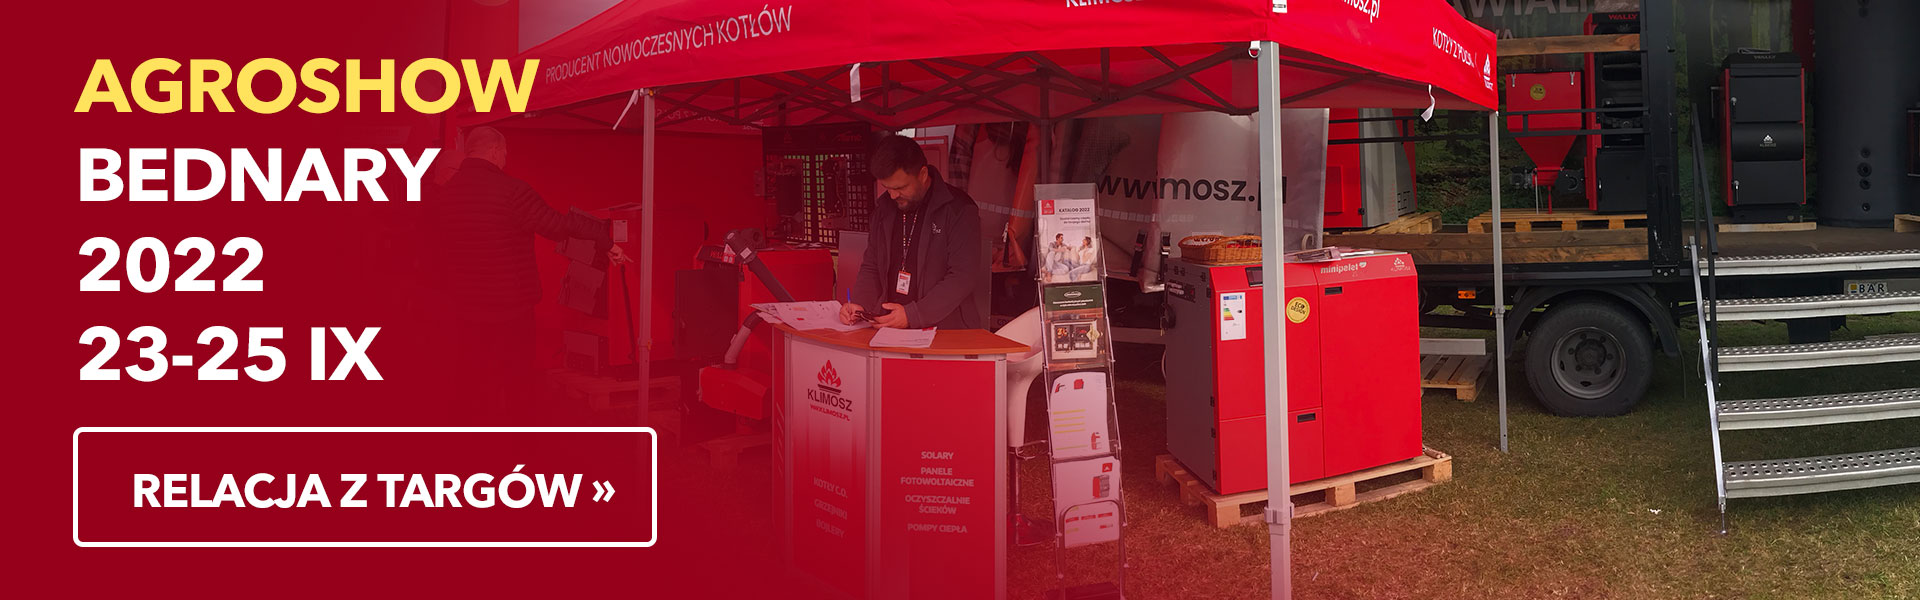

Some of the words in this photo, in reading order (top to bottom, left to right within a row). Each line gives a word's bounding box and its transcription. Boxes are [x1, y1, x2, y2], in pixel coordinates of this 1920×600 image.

[545, 52, 601, 84] PRODUCENT
[602, 24, 714, 67] NOWOCZESNYCH
[716, 4, 792, 44] KOTŁÓW
[1859, 283, 1885, 294] BÄR
[807, 388, 853, 412] KLIMOSZ
[921, 451, 954, 459] SOLARY
[920, 467, 953, 475] PANELE
[900, 477, 975, 487] FOTOWOLTAICZNE
[905, 495, 971, 505] OCZYSZCZALNIE
[919, 503, 957, 514] ŚCIEKÓW
[907, 523, 938, 532] POMPY
[939, 524, 968, 533] CIEPŁA
